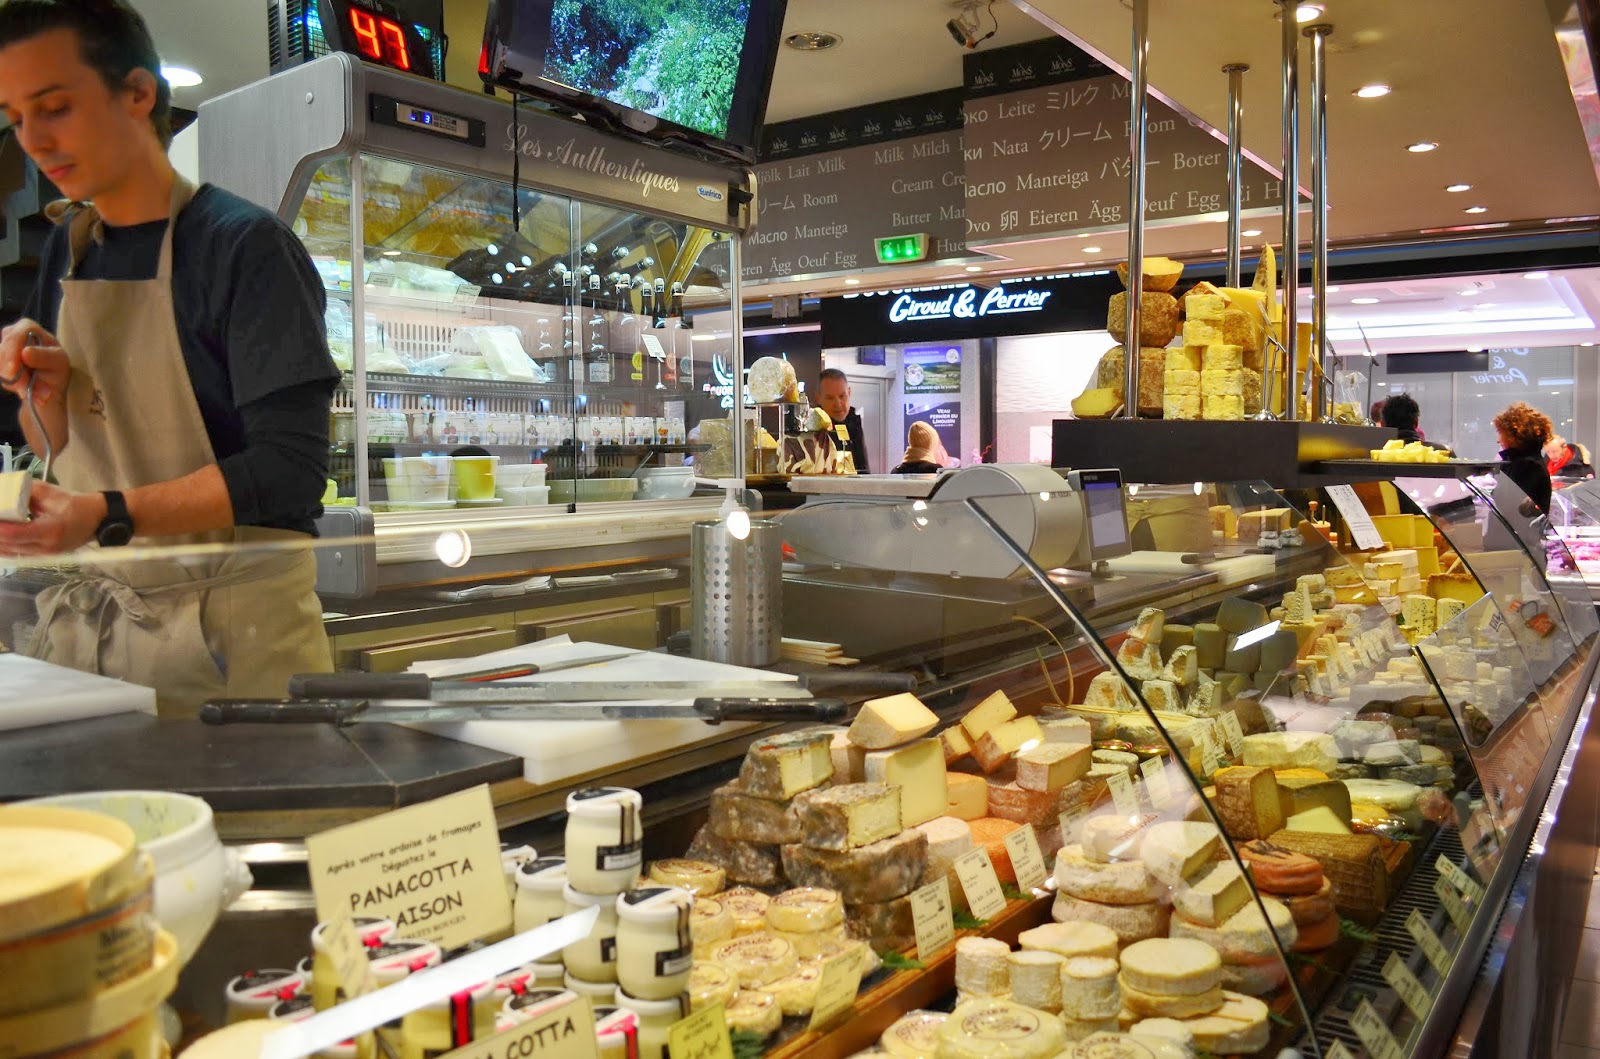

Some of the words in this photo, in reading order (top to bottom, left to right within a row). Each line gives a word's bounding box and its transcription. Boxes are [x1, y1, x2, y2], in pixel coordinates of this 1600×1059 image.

[351, 9, 409, 70] 47
[998, 101, 1036, 120] Leite
[1047, 84, 1099, 110] ミルク
[874, 149, 904, 165] Milk
[912, 139, 950, 158] Milch
[992, 139, 1029, 157] Nata
[1039, 121, 1112, 151] クリーム
[506, 122, 542, 160] Les
[546, 138, 680, 198] Authentiques
[788, 163, 810, 180] Lait
[817, 157, 846, 174] Milk
[965, 181, 1007, 197] асло
[1016, 169, 1089, 192] Manteiga
[1173, 152, 1221, 170] Boter
[803, 193, 838, 209] Room
[892, 179, 934, 195] Cream
[892, 211, 932, 228] Butter
[1000, 210, 1019, 231] 卵
[1029, 209, 1078, 227] Eieren
[1088, 200, 1121, 223] Ägg
[1187, 190, 1221, 213] Egg
[795, 222, 849, 241] Manteiga
[769, 257, 791, 276] Ägg
[798, 256, 829, 269] Oeuf
[835, 251, 857, 269] Egg
[889, 295, 950, 322] Giroud
[953, 289, 976, 318] &
[979, 286, 1051, 316] Perrier
[327, 859, 356, 875] Après
[359, 850, 385, 864] votre
[388, 838, 423, 856] ardoise
[426, 834, 437, 844] de
[441, 820, 482, 839] fromages
[381, 854, 425, 874] Dégustez
[428, 849, 437, 859] le
[350, 857, 473, 912] PANACOTTA
[388, 891, 463, 928] AISON
[506, 1015, 577, 1059] COTTA
